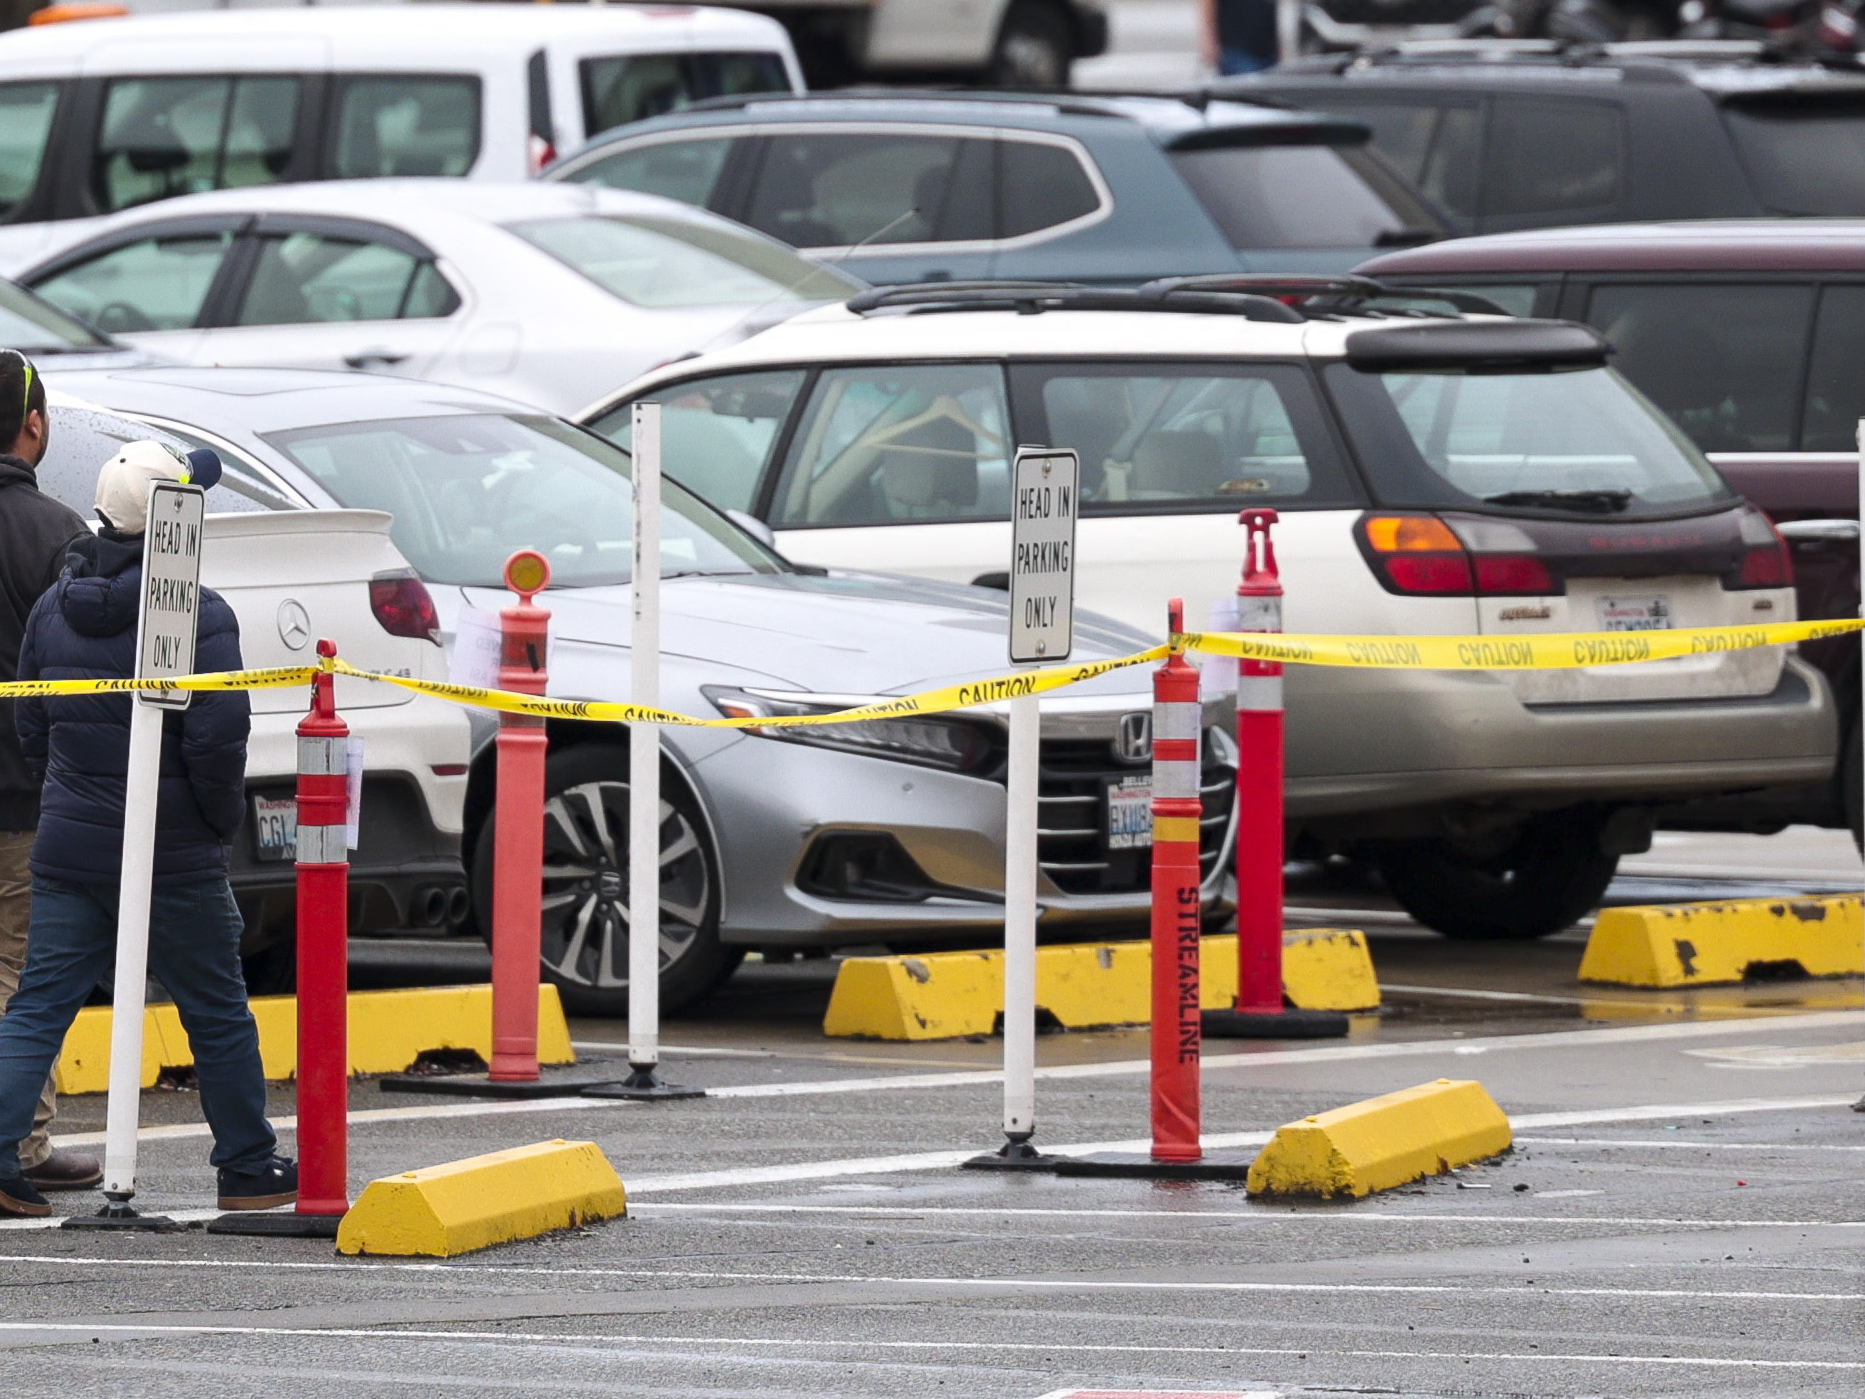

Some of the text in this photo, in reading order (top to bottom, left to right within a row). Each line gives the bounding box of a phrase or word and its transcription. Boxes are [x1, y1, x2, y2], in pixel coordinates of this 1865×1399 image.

[1020, 486, 1071, 520] HEAD IN
[154, 519, 197, 557] HEAD IN
[1017, 540, 1069, 575] PARKING
[149, 576, 194, 615] PARKING
[1025, 596, 1057, 629] ONLY
[153, 634, 181, 669] ONLY
[959, 676, 1036, 704] CAUTION
[1177, 887, 1199, 1064] STREAMLINE
